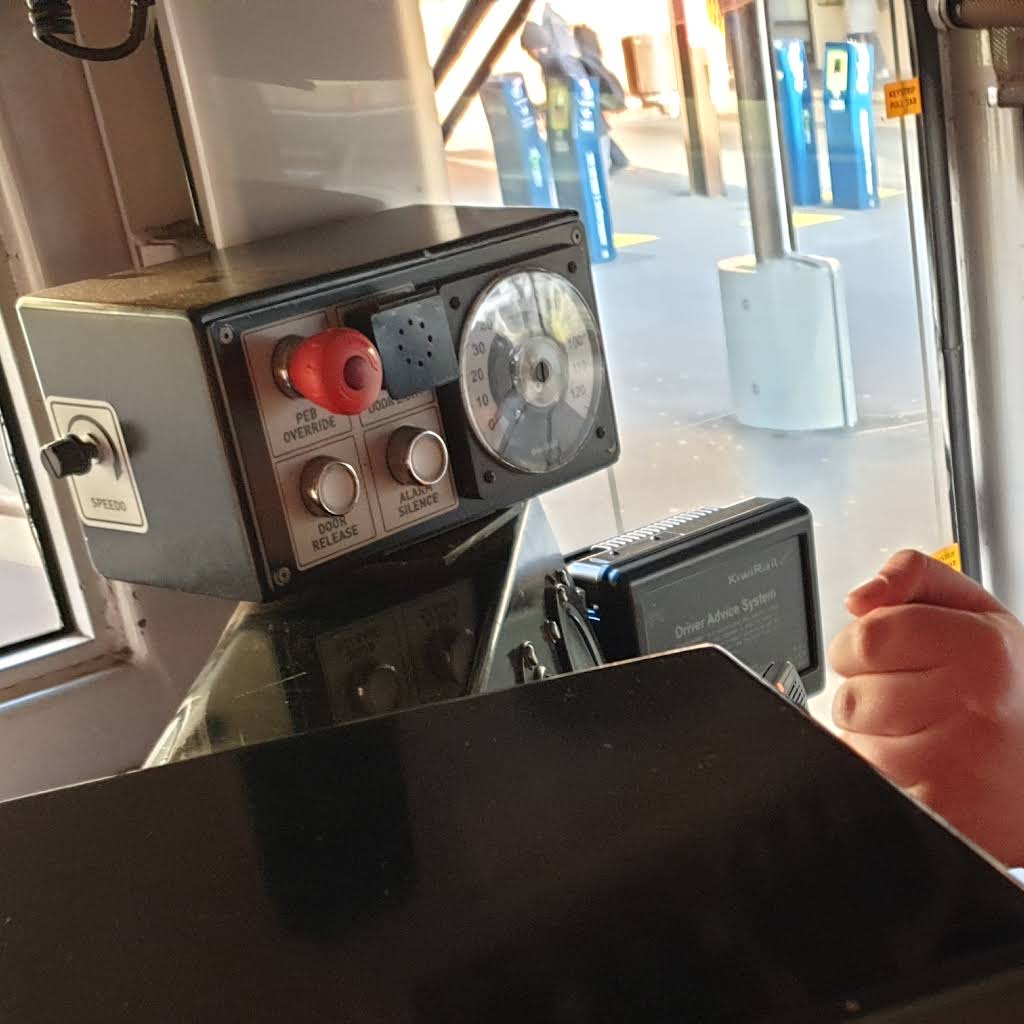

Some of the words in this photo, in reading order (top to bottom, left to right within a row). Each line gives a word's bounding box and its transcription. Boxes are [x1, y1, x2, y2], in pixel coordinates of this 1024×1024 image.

[472, 340, 486, 356] 30
[471, 367, 484, 383] 20
[476, 394, 489, 407] 10
[296, 408, 318, 425] PEB
[283, 415, 337, 444] OVERRIDE
[400, 484, 434, 502] ALARM
[91, 497, 127, 512] SPEEDO
[398, 492, 440, 517] SILENCE
[318, 515, 348, 535] DOOR
[312, 525, 360, 551] RELEASE
[674, 619, 706, 640] Driver
[706, 603, 740, 627] Advice
[741, 589, 778, 613] System
